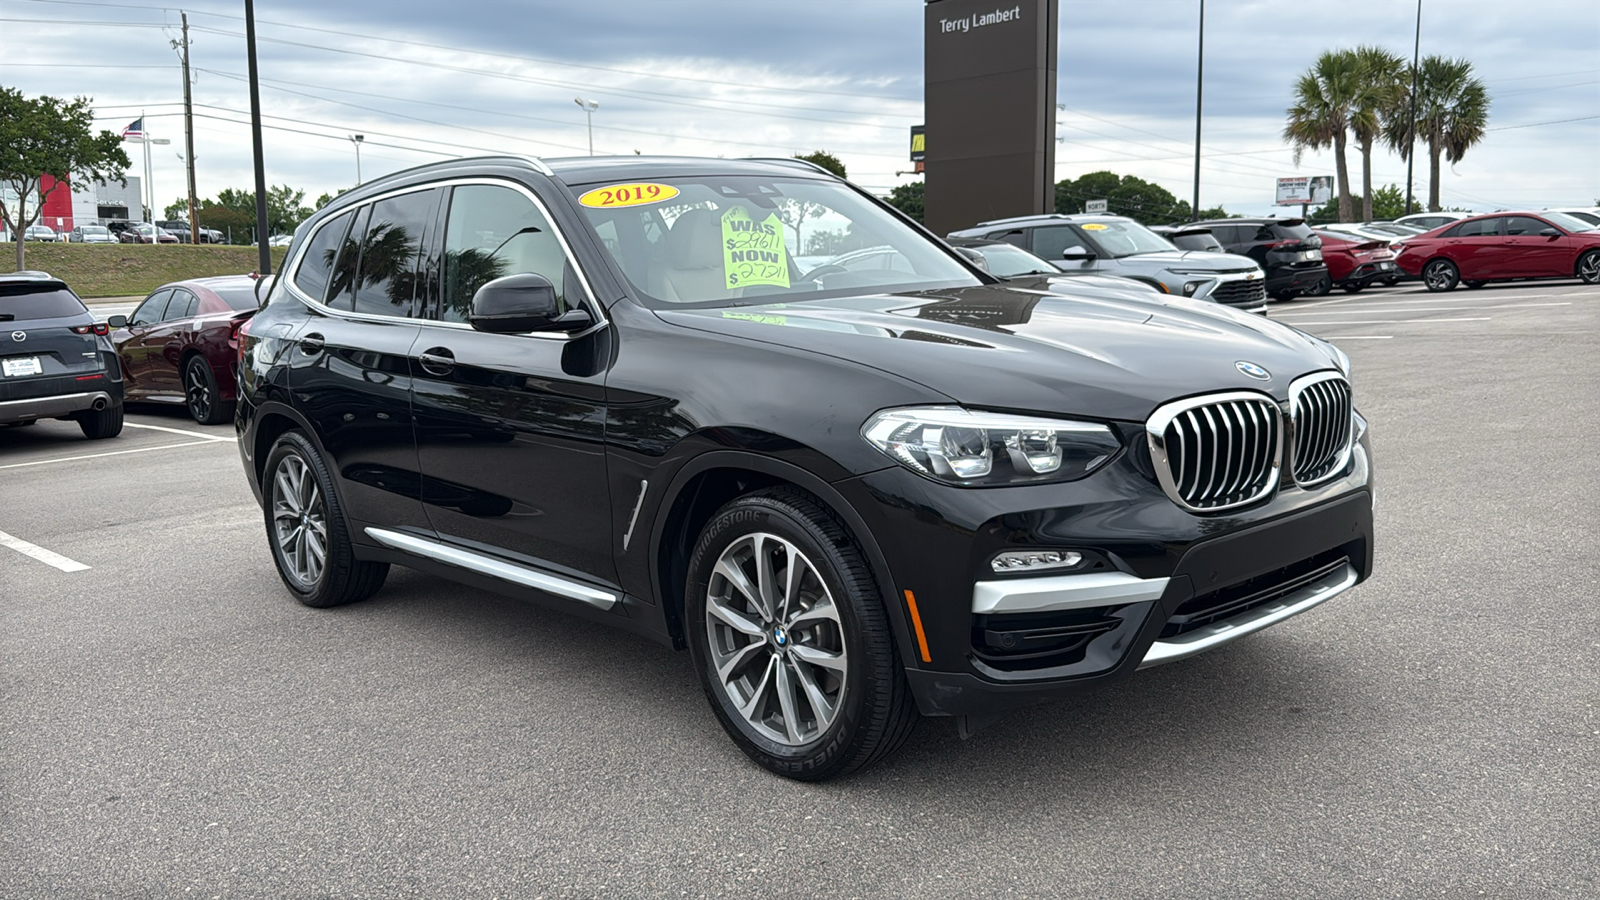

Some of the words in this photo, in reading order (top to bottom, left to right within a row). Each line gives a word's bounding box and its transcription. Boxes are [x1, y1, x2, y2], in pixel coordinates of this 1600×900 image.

[939, 17, 970, 33] Terry
[972, 5, 1020, 27] Lambert
[599, 185, 661, 206] 2019
[1087, 202, 1106, 211] NORTH
[730, 220, 776, 236] WAS
[731, 249, 779, 264] NOW
